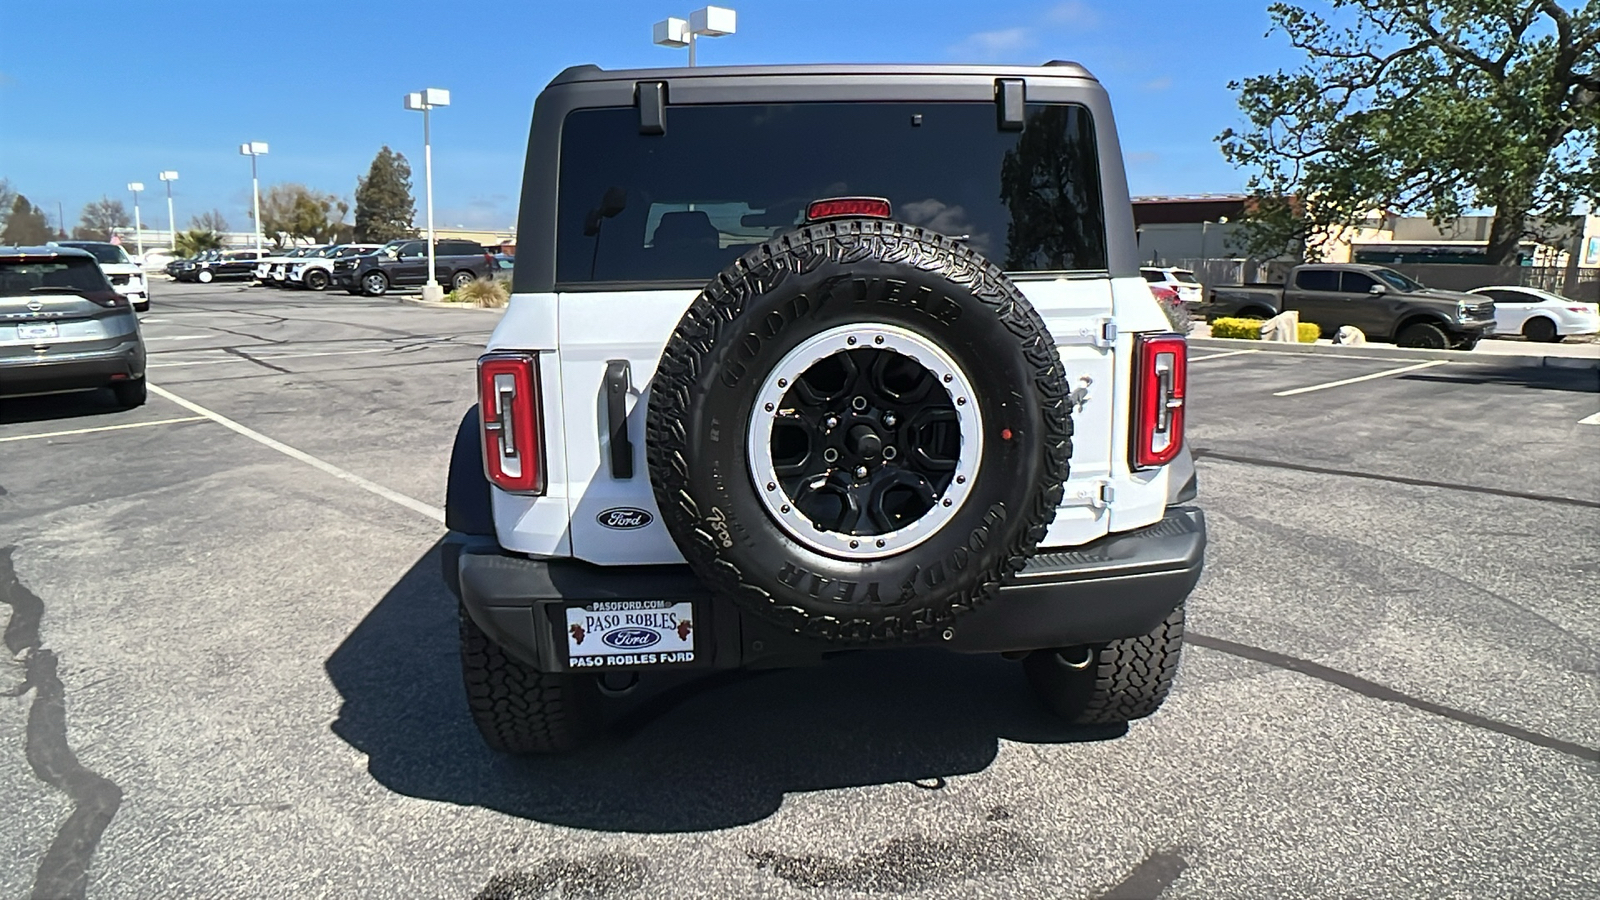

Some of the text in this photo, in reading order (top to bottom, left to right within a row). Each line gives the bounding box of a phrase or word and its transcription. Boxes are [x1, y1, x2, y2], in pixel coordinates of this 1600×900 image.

[608, 511, 642, 526] Ford
[592, 600, 665, 612] PASOFORD.COM
[586, 612, 677, 634] PASO ROBLES
[614, 630, 650, 646] Ford
[569, 651, 695, 667] PASO ROBLES FORD
